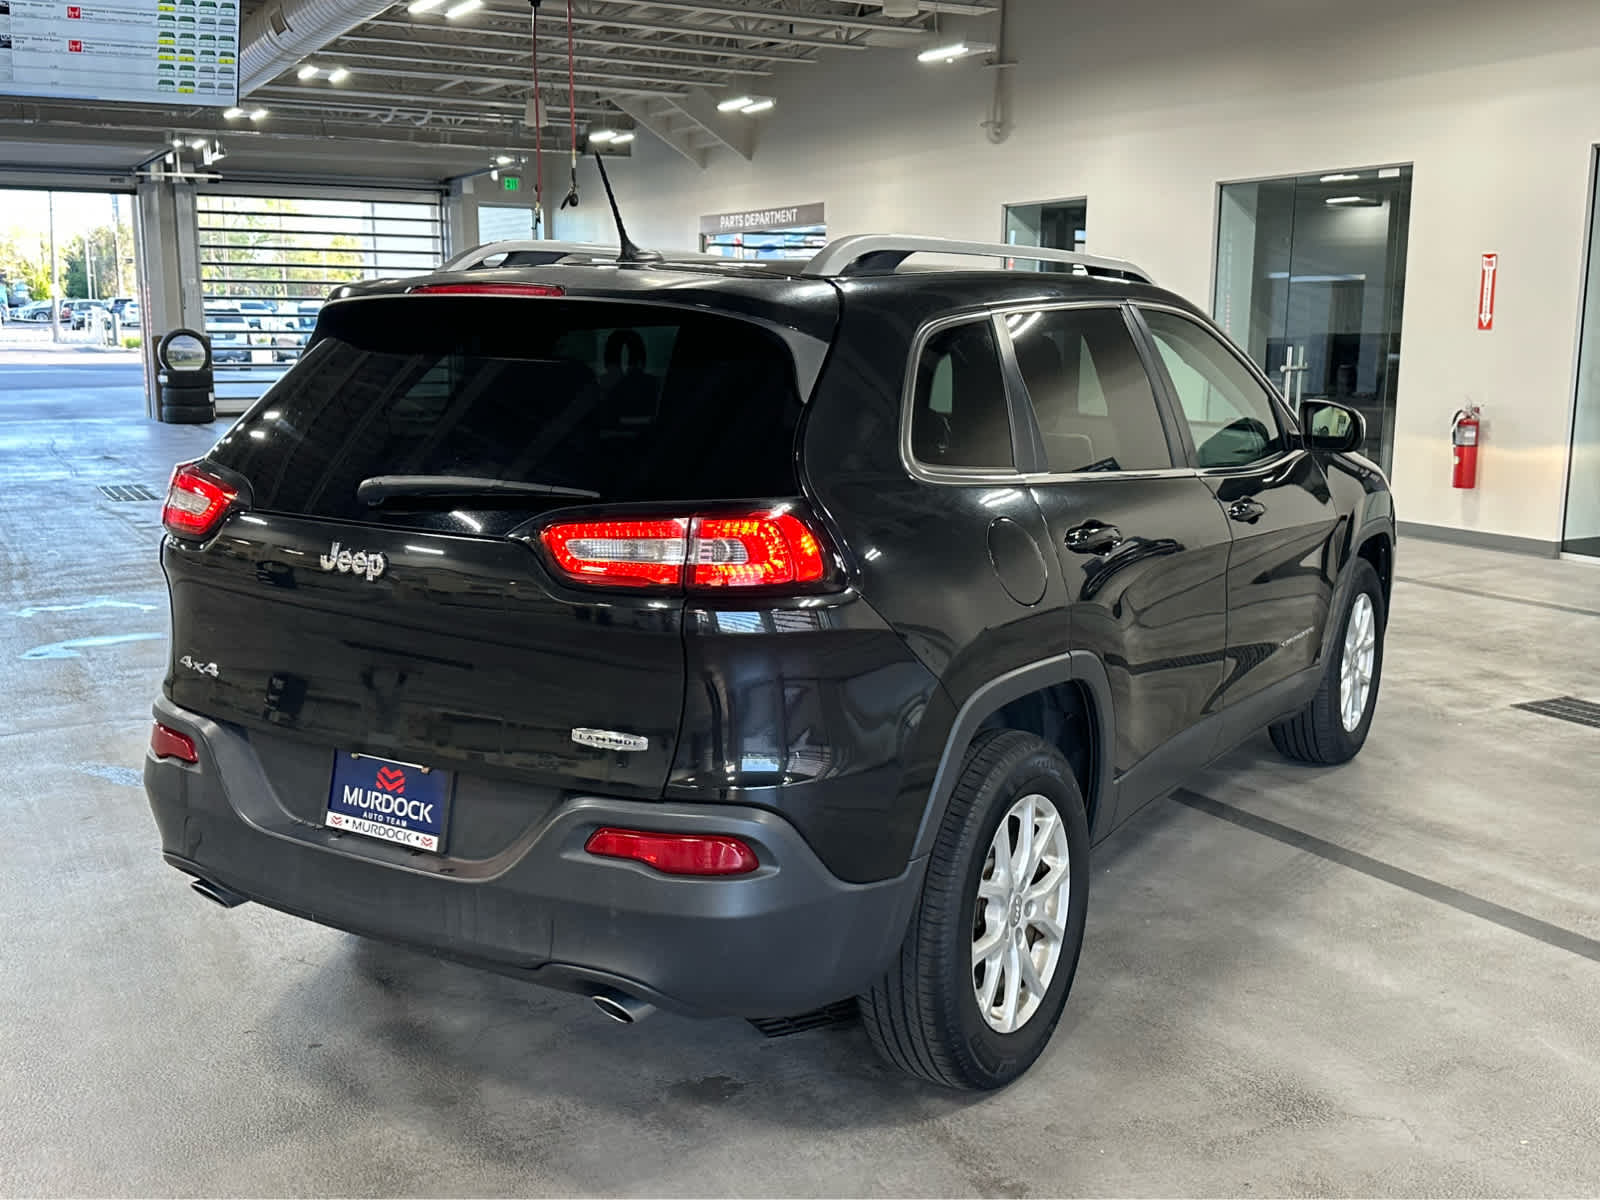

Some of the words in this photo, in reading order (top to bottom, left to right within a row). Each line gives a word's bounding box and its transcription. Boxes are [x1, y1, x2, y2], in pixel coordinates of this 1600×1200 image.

[720, 214, 744, 228] PARTS
[744, 208, 798, 226] DEPARTMENT
[320, 542, 384, 581] Jeep
[180, 655, 219, 677] 4x4
[343, 784, 434, 823] MURDOCK
[362, 811, 384, 822] AUTO
[386, 815, 407, 827] TEAM
[351, 820, 412, 842] MURDOCK
